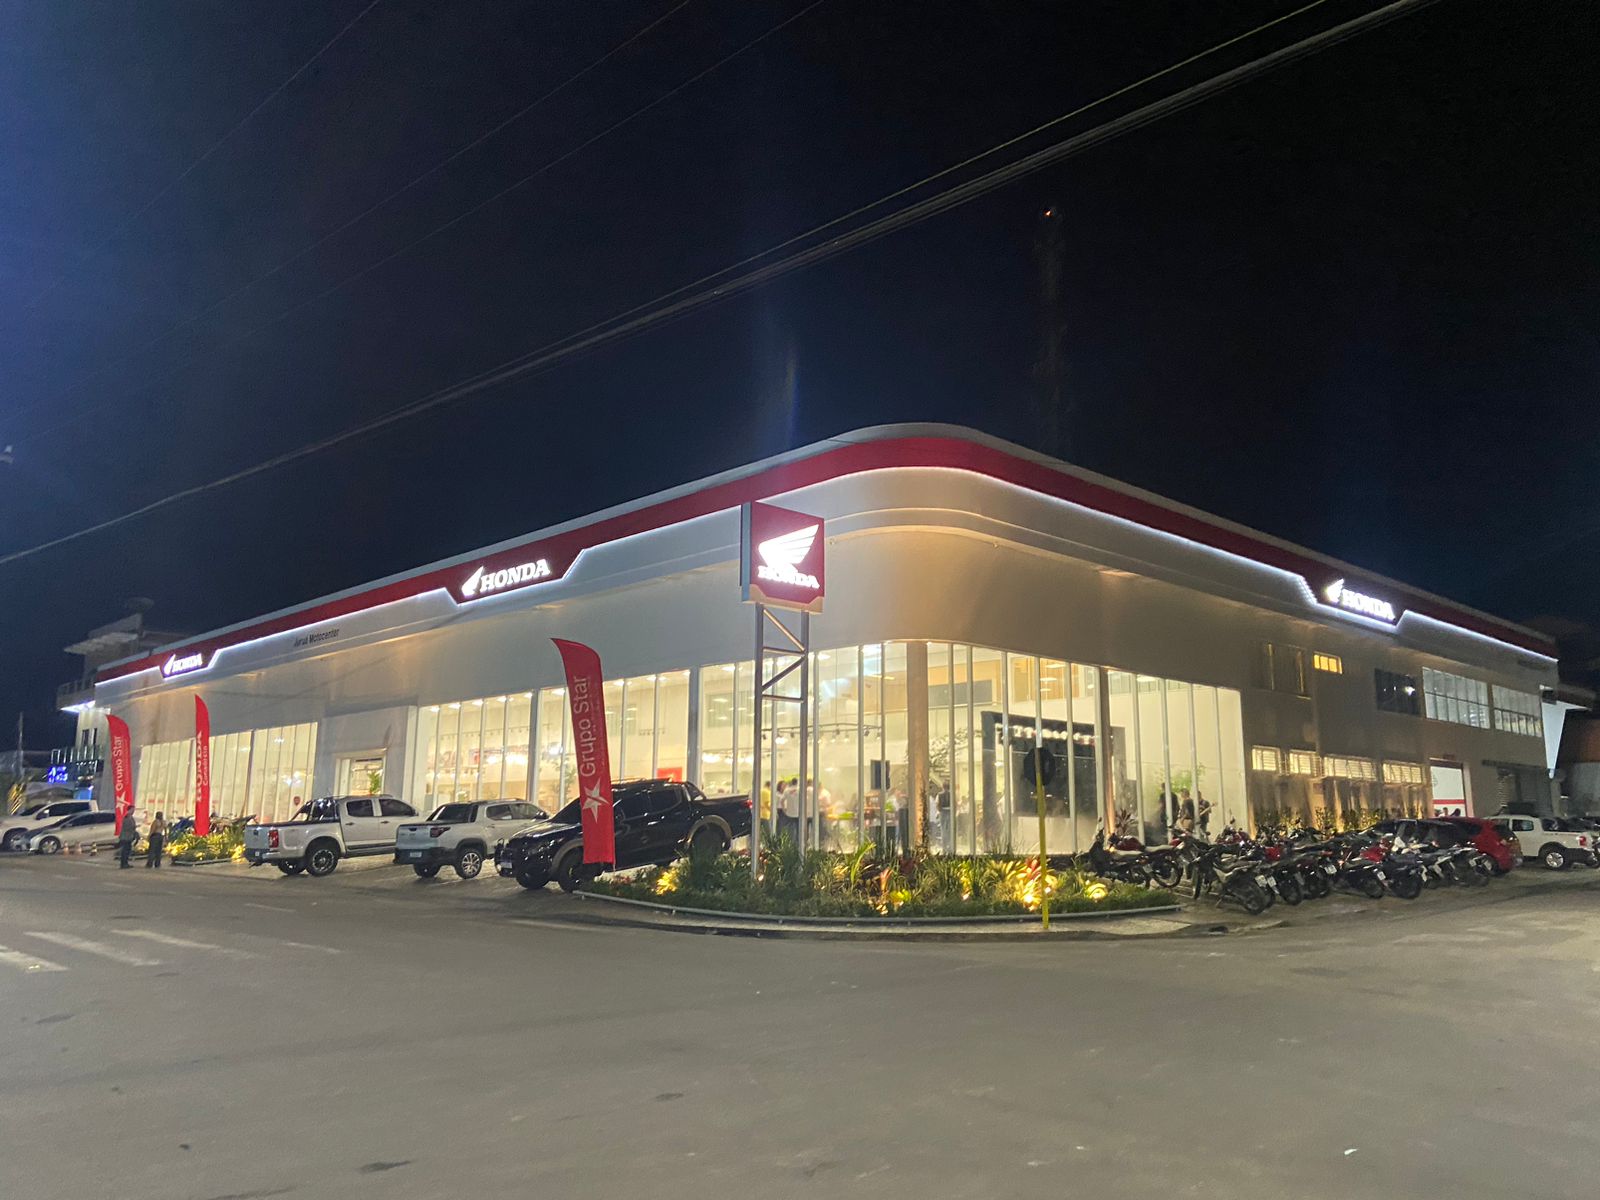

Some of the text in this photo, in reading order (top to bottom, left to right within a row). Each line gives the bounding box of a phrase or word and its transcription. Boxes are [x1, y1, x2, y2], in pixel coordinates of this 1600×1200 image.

[480, 559, 550, 592] HONDA
[758, 566, 820, 588] HONDA
[1342, 588, 1395, 620] HONDA
[172, 653, 203, 672] HONDA
[573, 675, 590, 714] Star
[112, 735, 124, 792] Grupo Star
[578, 718, 597, 777] Grupo
